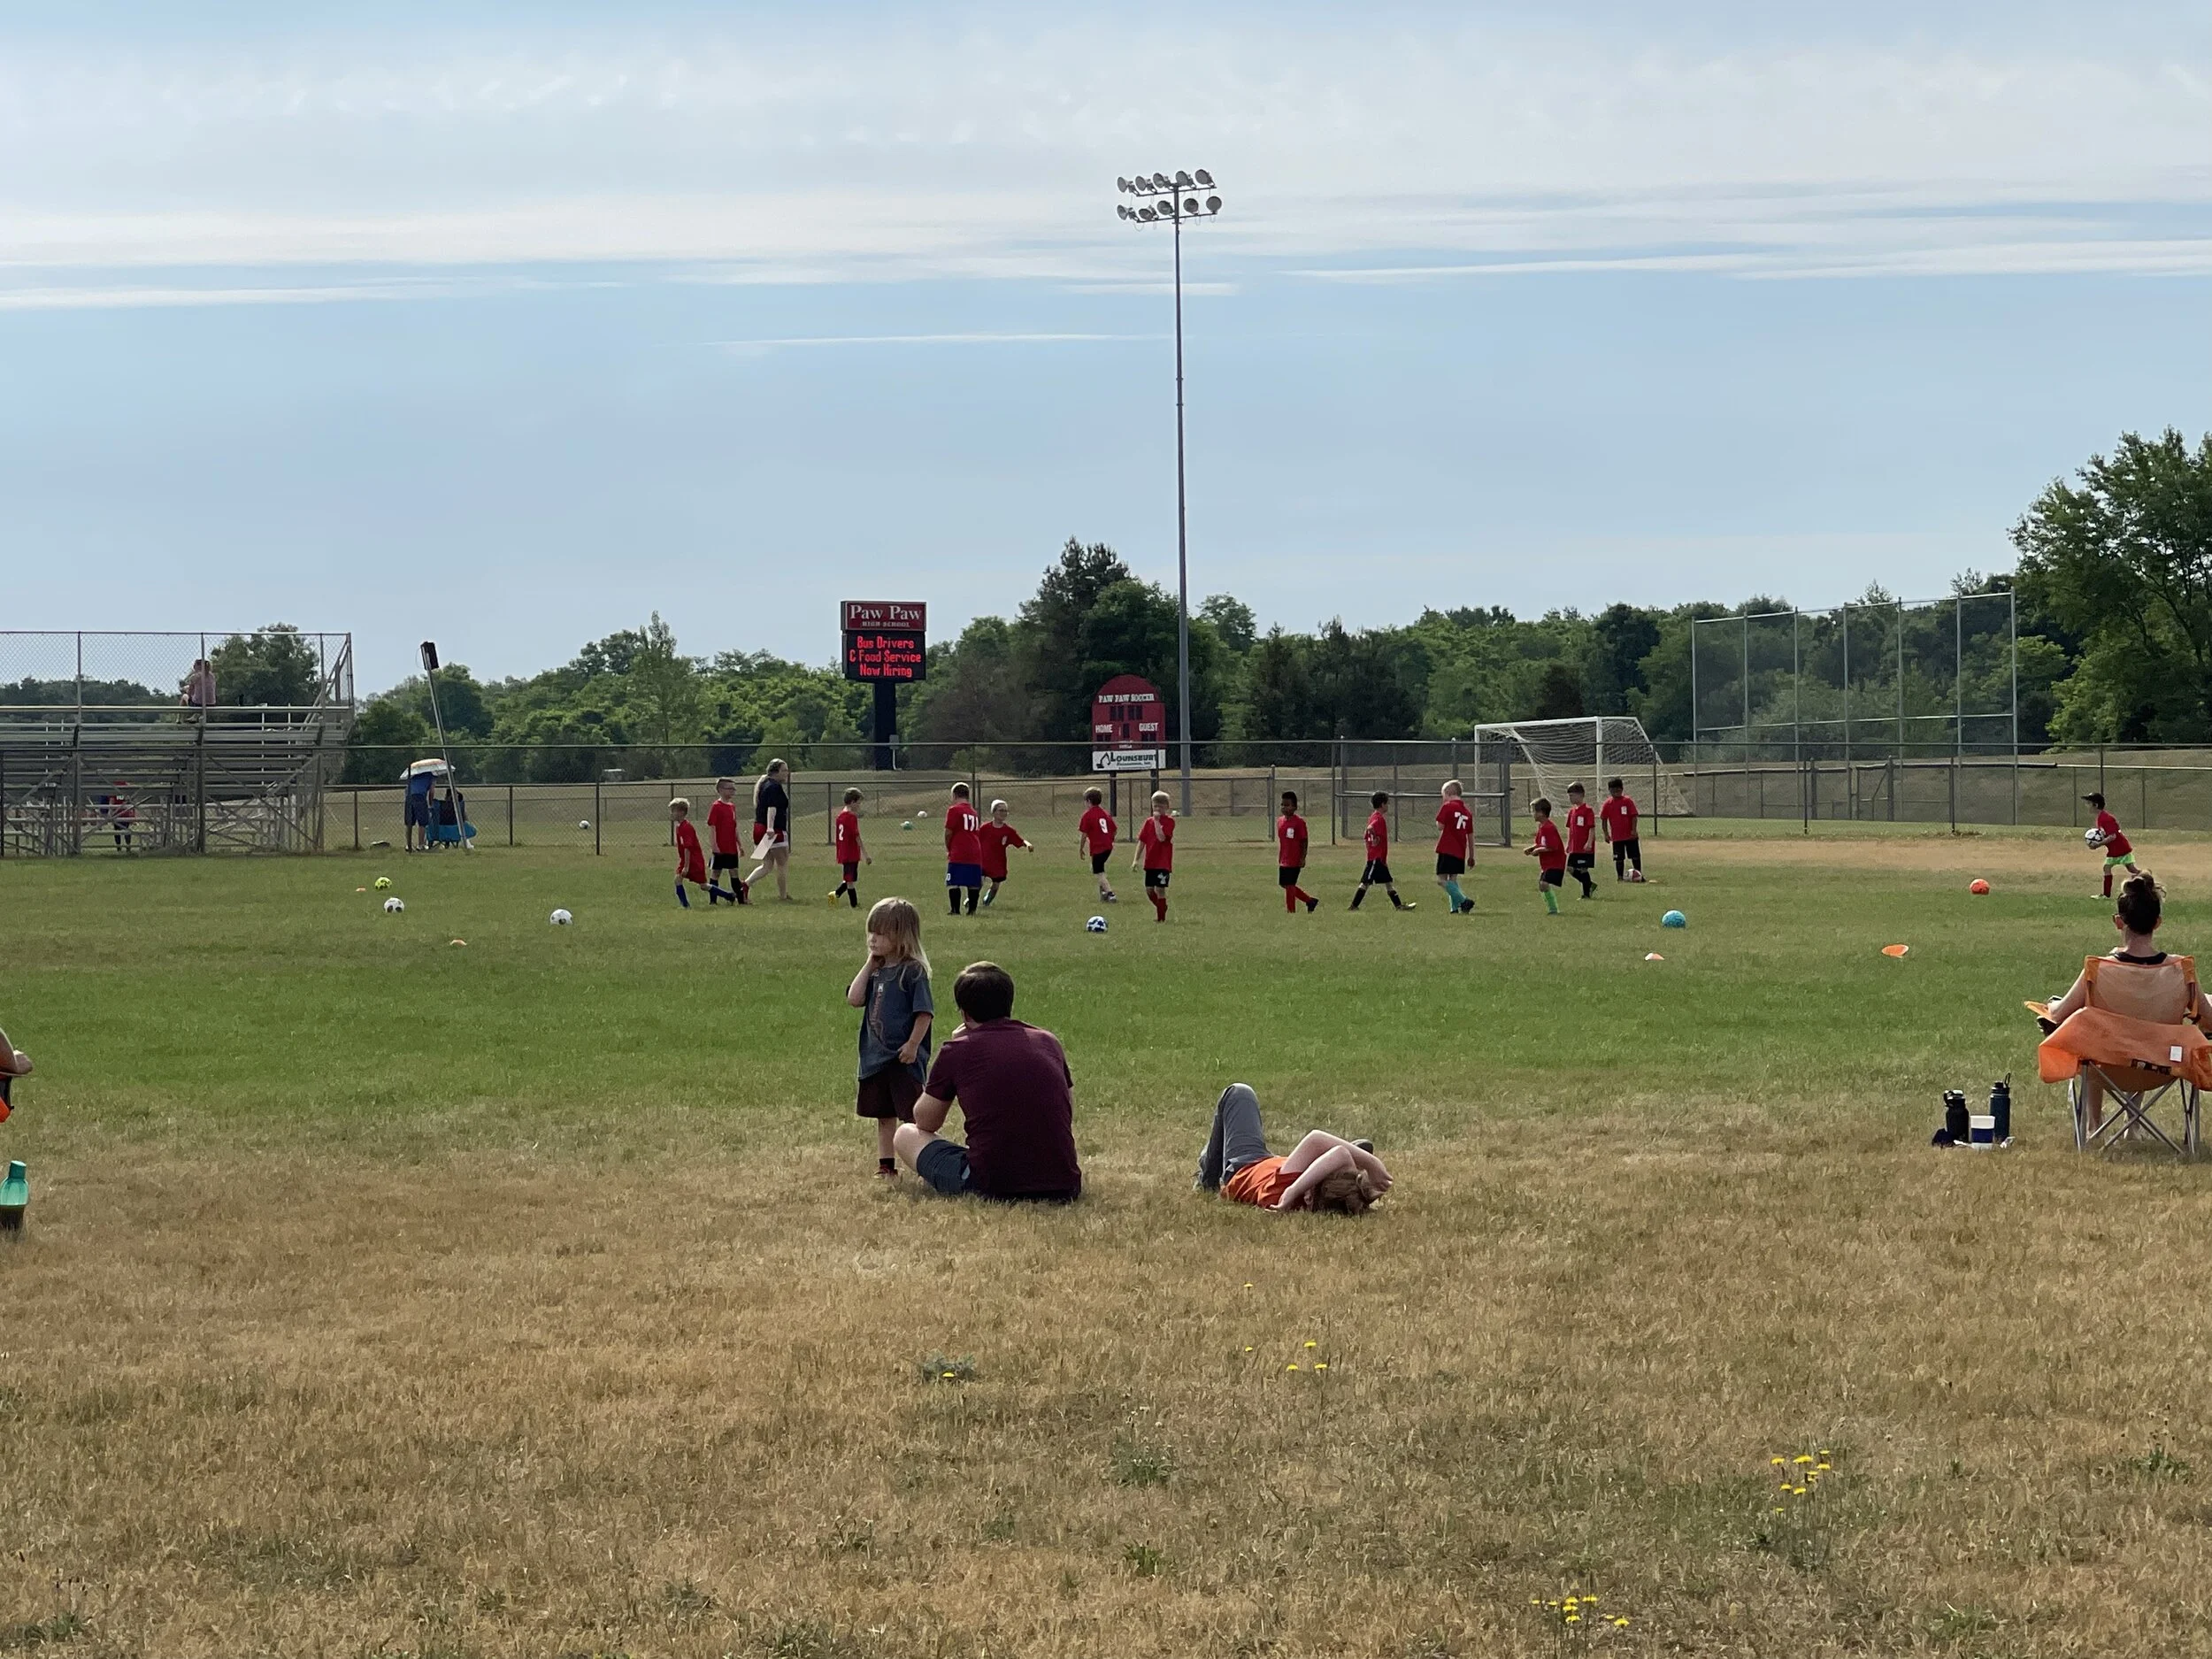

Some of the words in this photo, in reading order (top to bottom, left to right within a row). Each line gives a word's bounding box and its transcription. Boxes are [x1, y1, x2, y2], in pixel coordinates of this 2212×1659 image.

[850, 604, 883, 619] Paw
[889, 605, 921, 620] Paw
[856, 636, 873, 649] Bus
[877, 636, 914, 649] Drivers
[858, 649, 882, 663] Food
[884, 649, 922, 663] Service
[859, 664, 880, 676] Now
[883, 664, 912, 678] Hiring
[1098, 695, 1114, 703] PAW
[1115, 694, 1130, 703] PAW
[1131, 693, 1155, 702] SOCCER
[1095, 724, 1113, 733] HOME
[1139, 722, 1158, 732] GUEST
[838, 824, 844, 841] 2
[1099, 818, 1108, 833] 9
